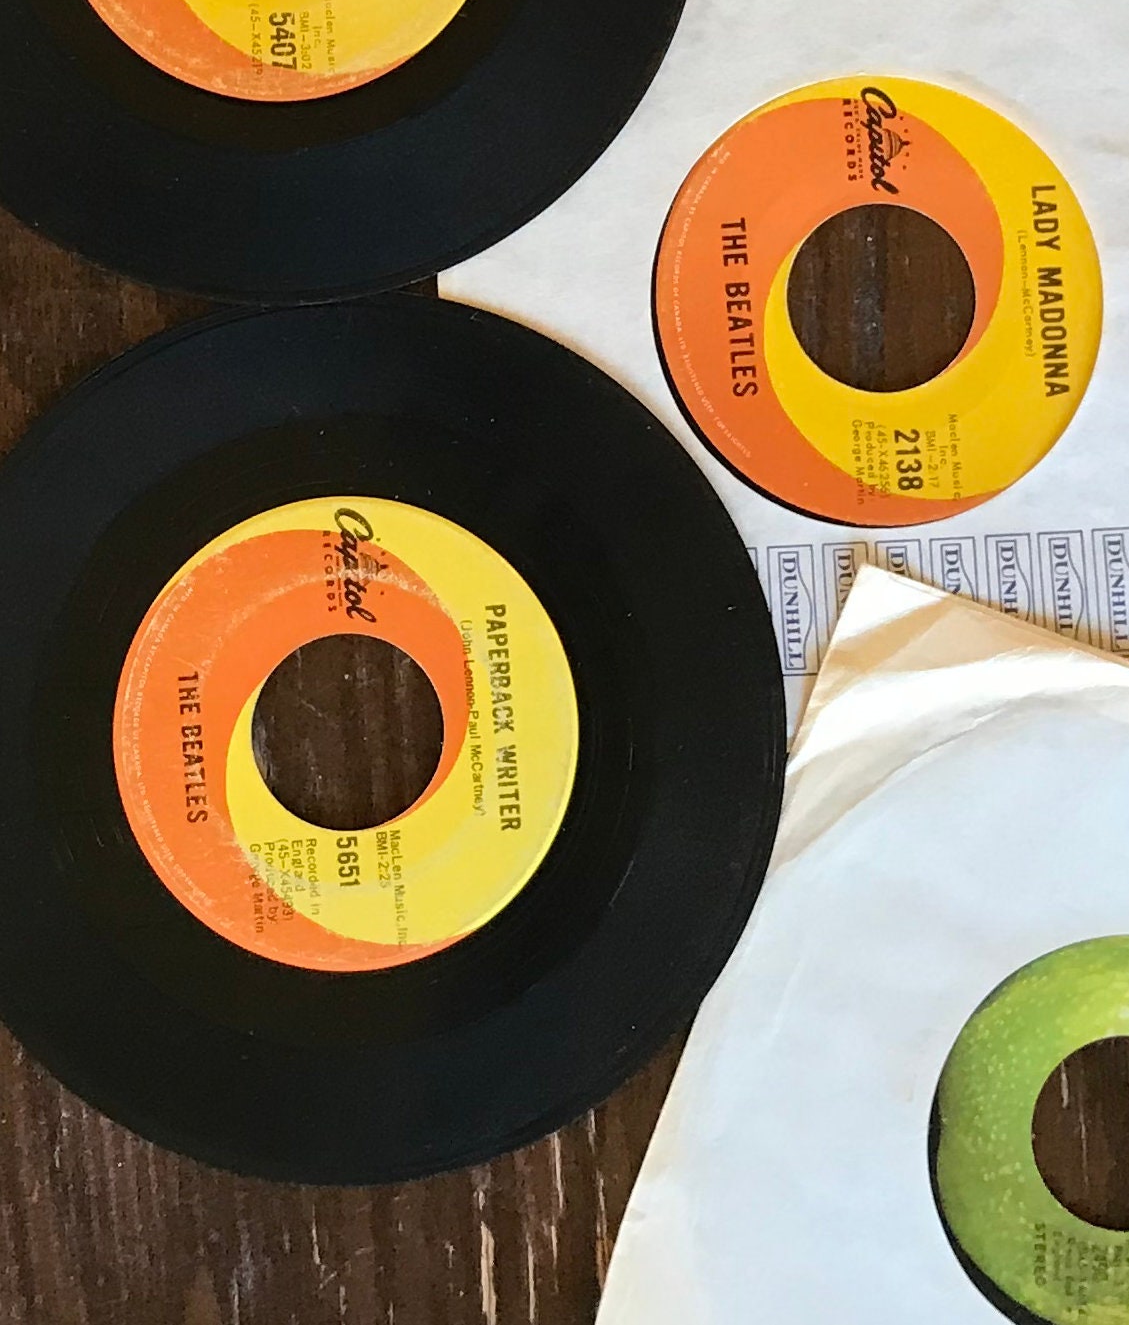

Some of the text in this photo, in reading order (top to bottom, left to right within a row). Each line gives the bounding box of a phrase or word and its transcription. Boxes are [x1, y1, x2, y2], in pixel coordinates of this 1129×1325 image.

[268, 12, 297, 71] 5407
[860, 87, 900, 195] Capitol
[720, 217, 749, 267] THE
[1031, 185, 1070, 398] LADY MADONNA
[724, 281, 758, 399] BEATLES
[852, 419, 865, 505] George Martin
[864, 421, 878, 478] Produced
[894, 428, 924, 491] 2138
[322, 530, 337, 612] RECORDS
[1000, 546, 1018, 614] DUNH
[1052, 543, 1074, 631] DUNHIL
[1107, 539, 1129, 650] DUNHILL
[459, 620, 473, 654] (John
[781, 557, 802, 667] DUNHILL
[178, 671, 208, 825] THE BEATLES
[485, 603, 522, 831] PAPERBACK WRITER
[336, 836, 360, 888] 5651
[389, 829, 403, 881] MacLen
[311, 903, 321, 916] in
[1033, 1223, 1046, 1289] STEREO
